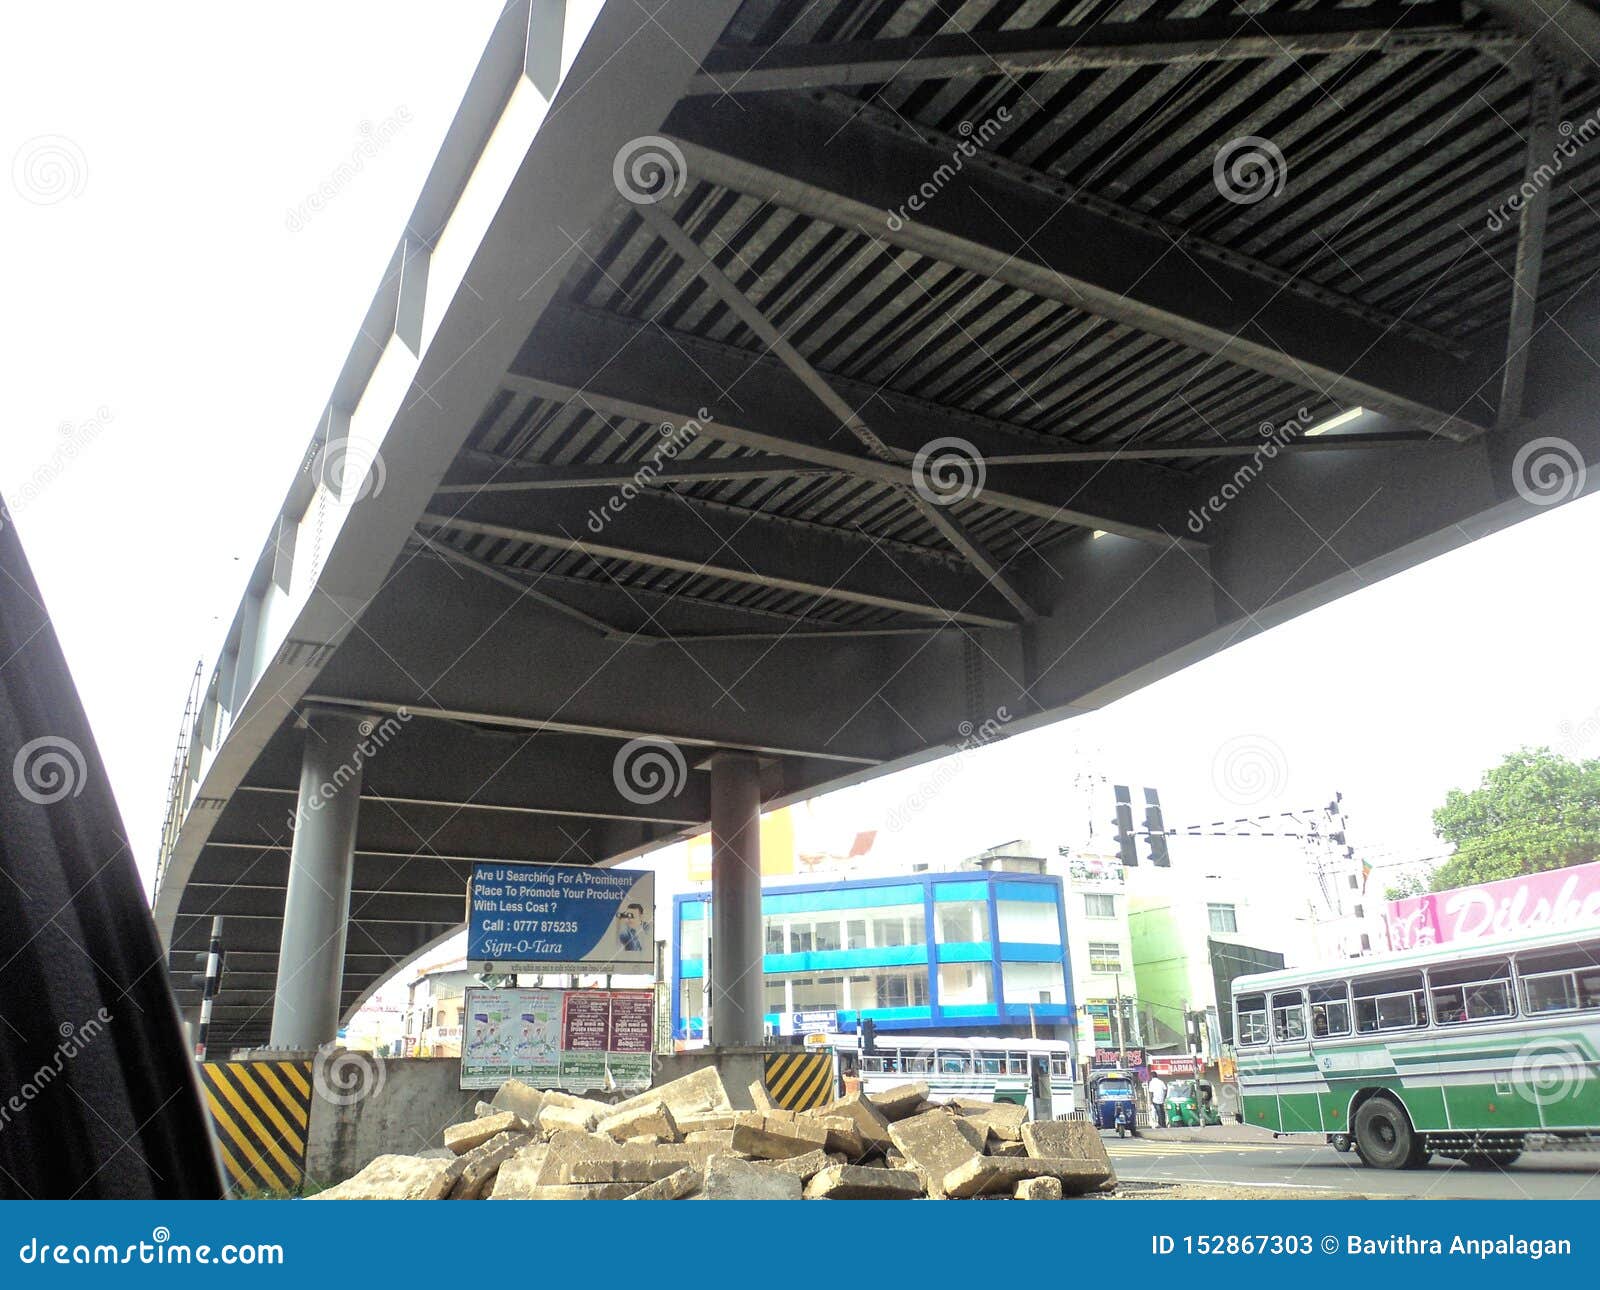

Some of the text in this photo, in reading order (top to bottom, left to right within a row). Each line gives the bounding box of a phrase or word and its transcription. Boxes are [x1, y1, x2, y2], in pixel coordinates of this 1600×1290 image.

[475, 869, 494, 881] Are
[495, 870, 504, 881] U
[506, 870, 555, 885] Searching
[557, 872, 573, 884] For
[585, 873, 633, 886] Prominent
[474, 884, 624, 900] Place To Promote Your Product
[474, 900, 497, 911] With
[500, 901, 523, 912] Less
[525, 901, 548, 913] Cost
[482, 919, 504, 931] Call
[513, 920, 538, 932] 0777
[541, 920, 578, 933] 875235
[481, 938, 562, 957] Sign-O-Tara
